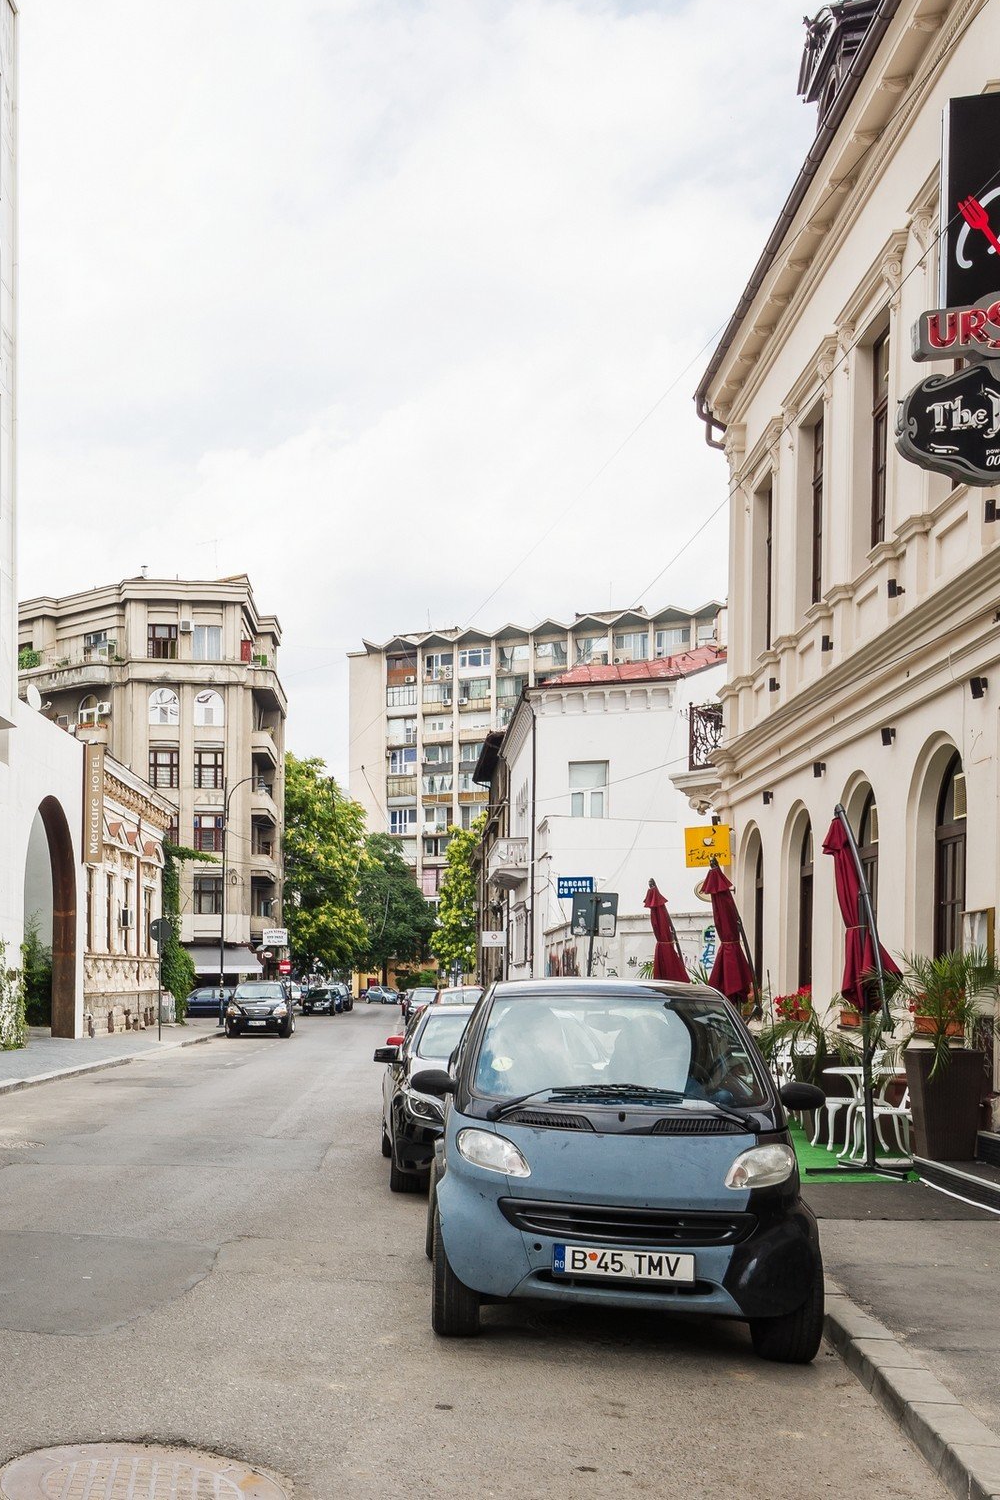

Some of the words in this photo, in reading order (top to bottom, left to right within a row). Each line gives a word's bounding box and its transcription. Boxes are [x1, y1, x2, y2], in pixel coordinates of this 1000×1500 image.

[926, 396, 989, 432] The
[92, 754, 100, 792] HOTEL
[90, 798, 100, 854] Mercure
[554, 1260, 564, 1268] RO
[571, 1250, 587, 1270] B
[596, 1252, 624, 1273] 45
[634, 1254, 681, 1277] TMV
